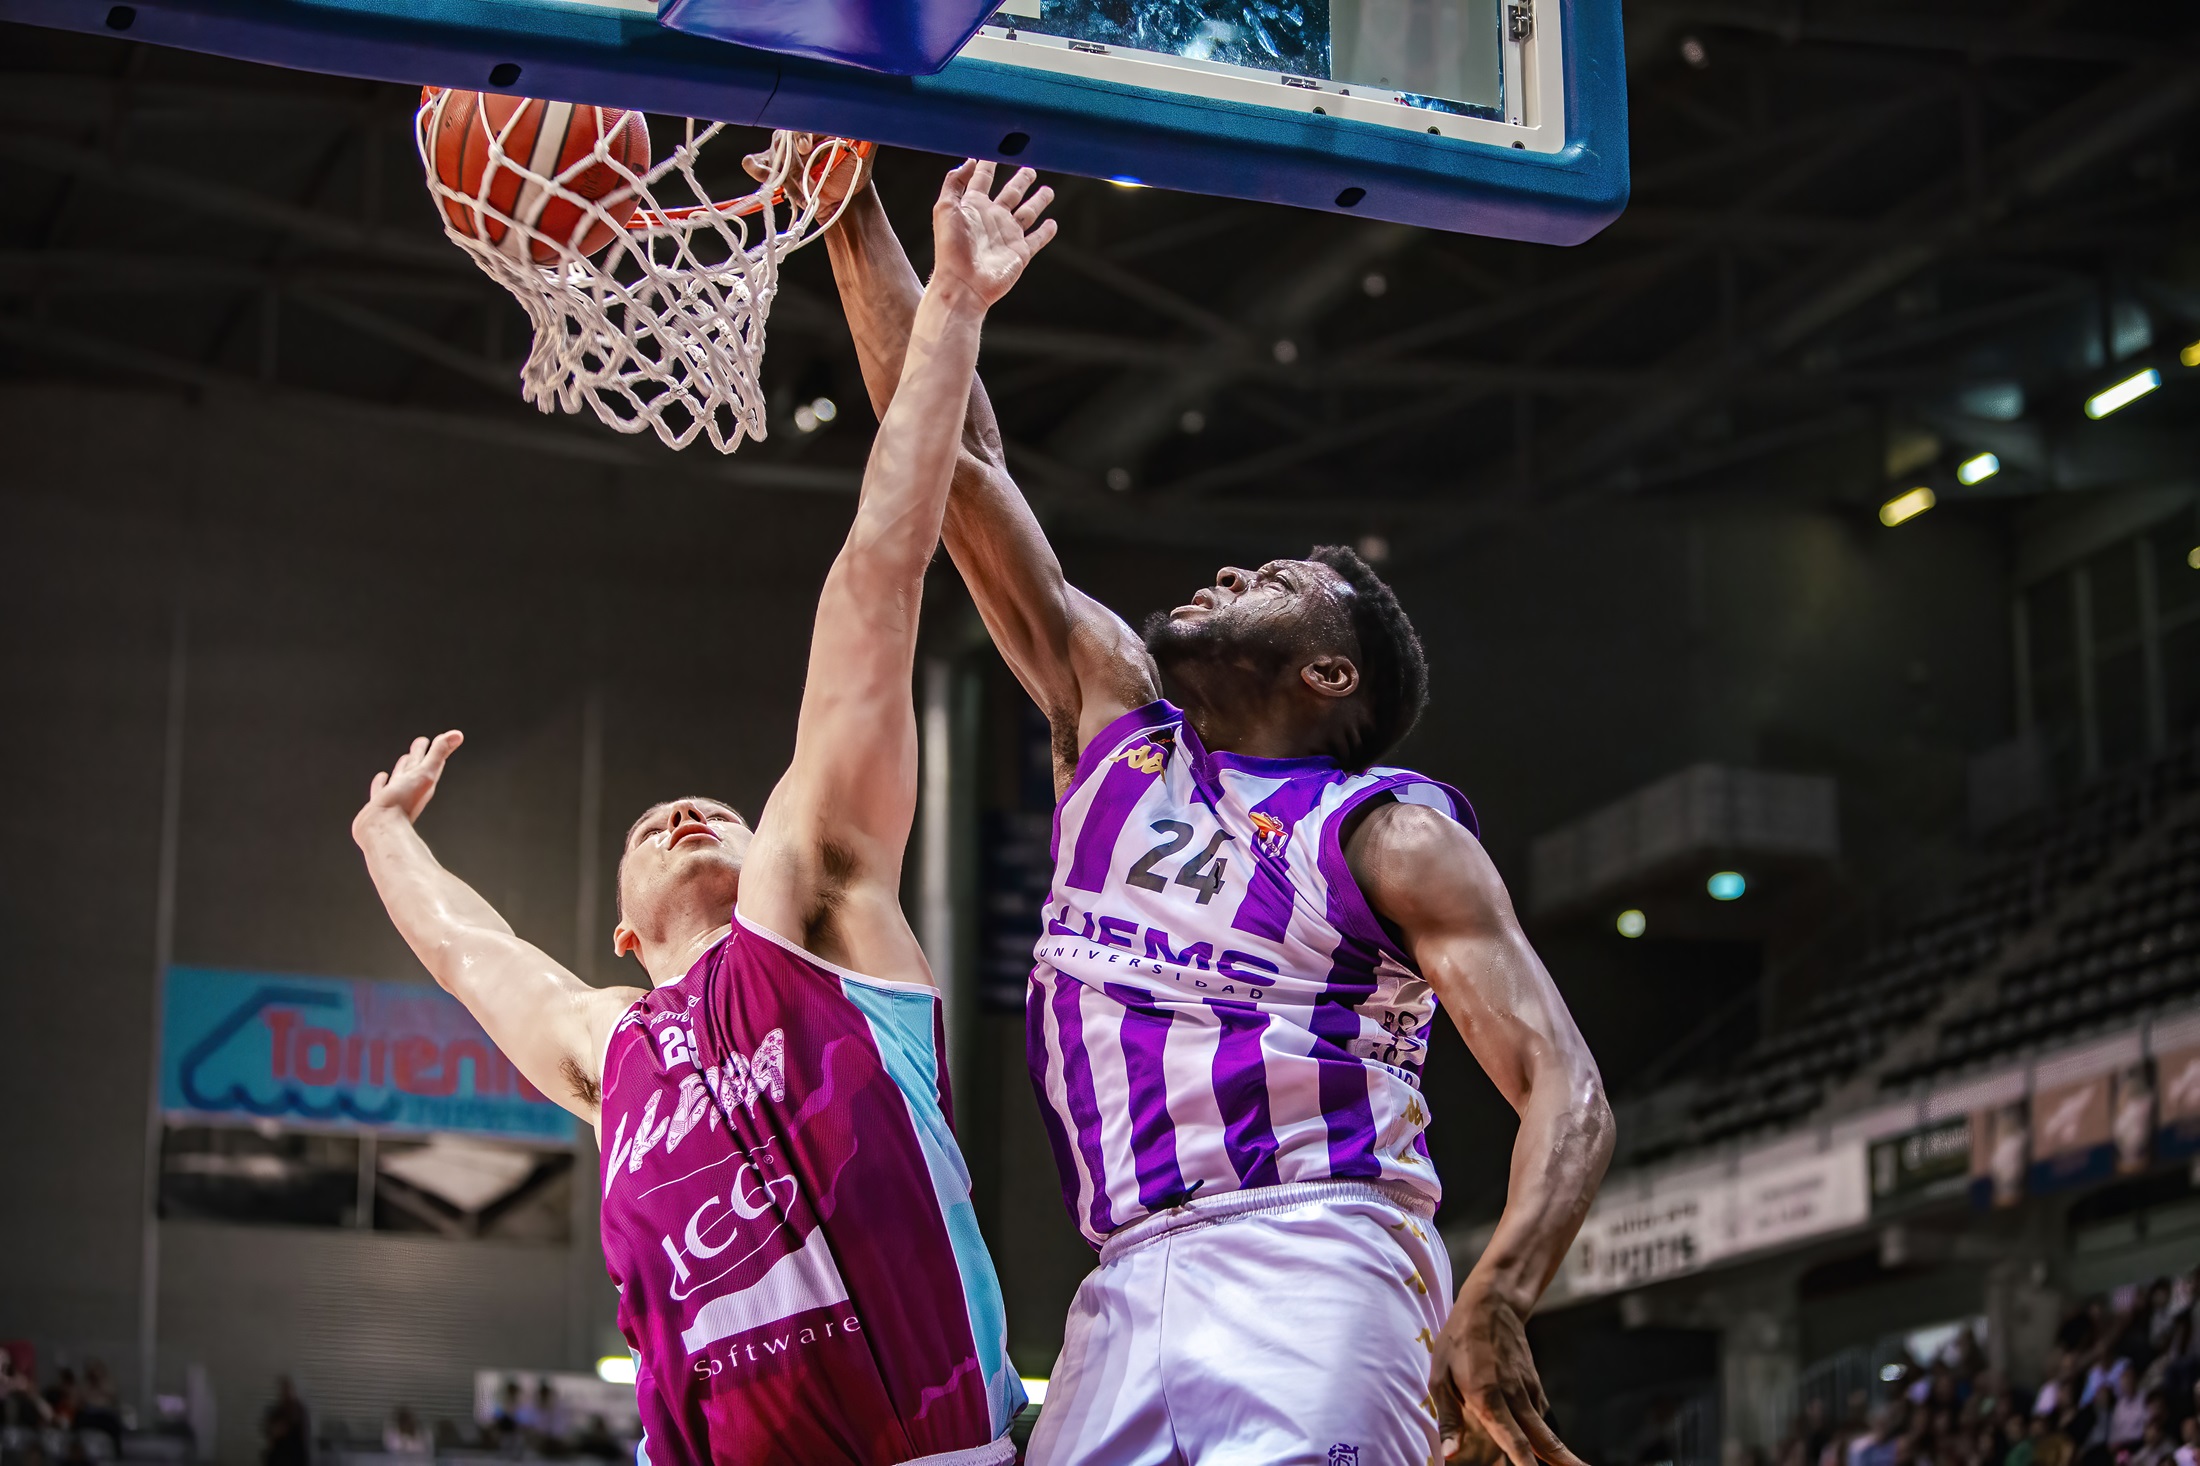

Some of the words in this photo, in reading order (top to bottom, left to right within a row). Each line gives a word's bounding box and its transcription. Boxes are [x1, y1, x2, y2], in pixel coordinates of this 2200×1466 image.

[1125, 818, 1236, 906] 24
[1039, 946, 1264, 1000] UNIVERSIDAD
[693, 1315, 861, 1381] Software
